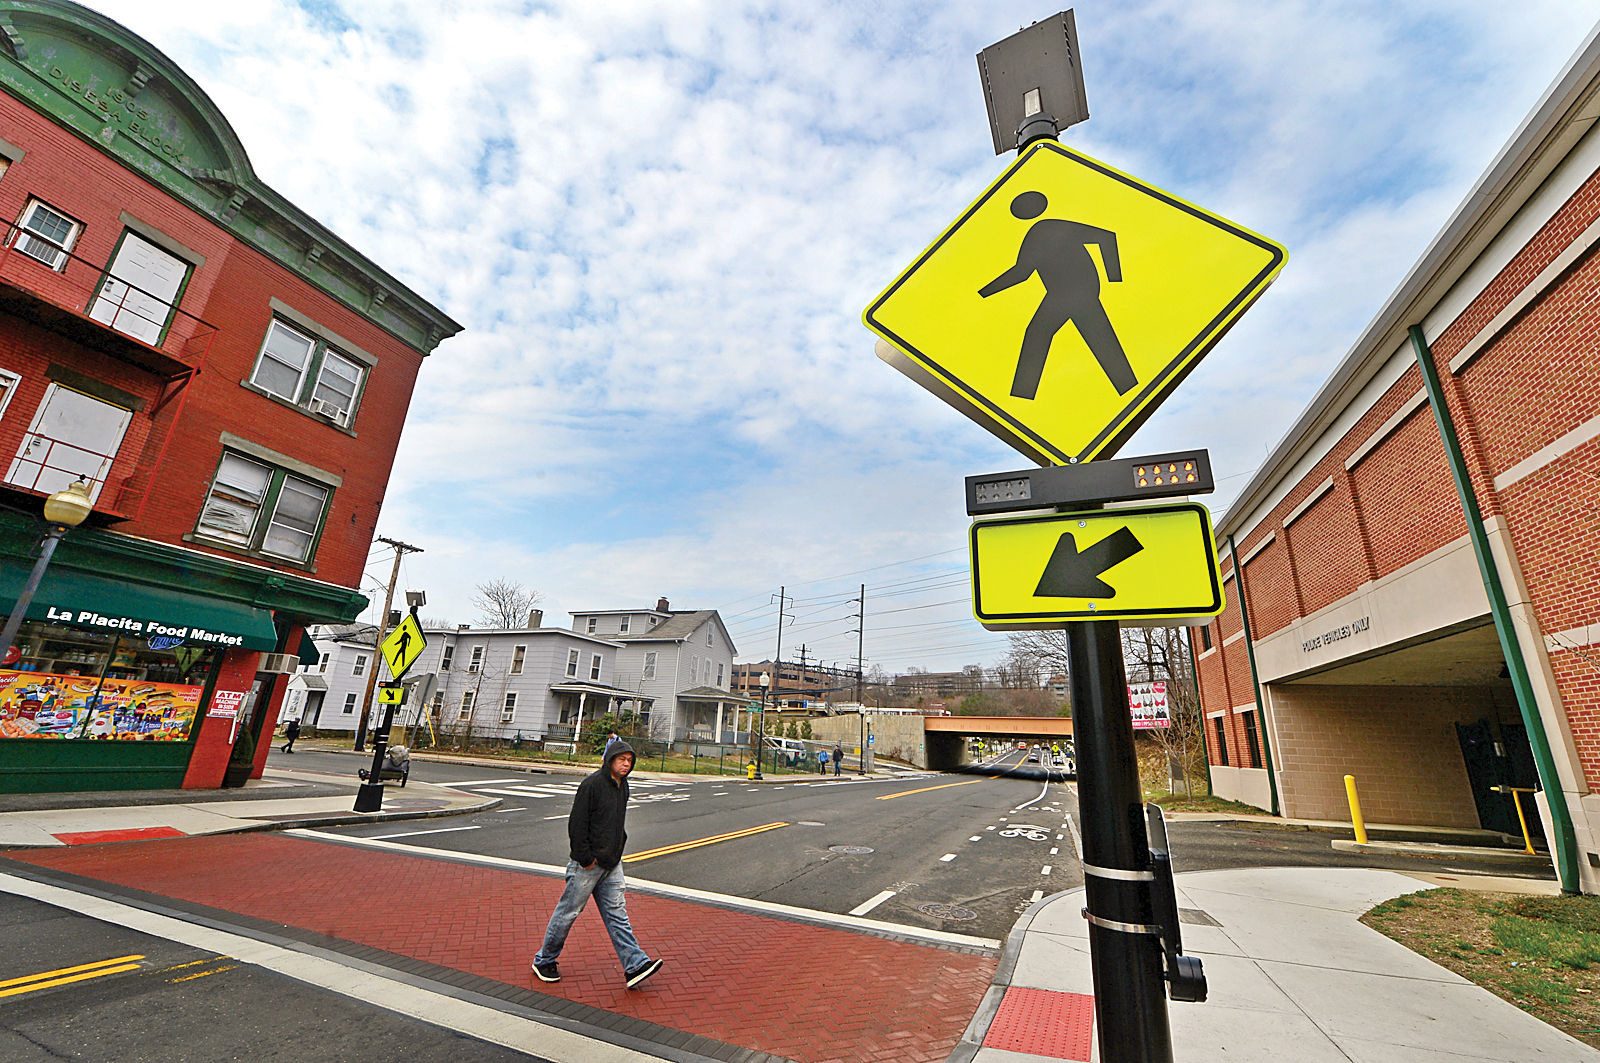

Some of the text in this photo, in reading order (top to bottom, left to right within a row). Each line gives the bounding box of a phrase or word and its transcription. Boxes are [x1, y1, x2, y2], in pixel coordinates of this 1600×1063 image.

[128, 120, 183, 163] BLOCK
[47, 606, 243, 646] La Placita Food Market
[1322, 624, 1351, 645] VEHICLES
[1352, 616, 1369, 634] ONLY
